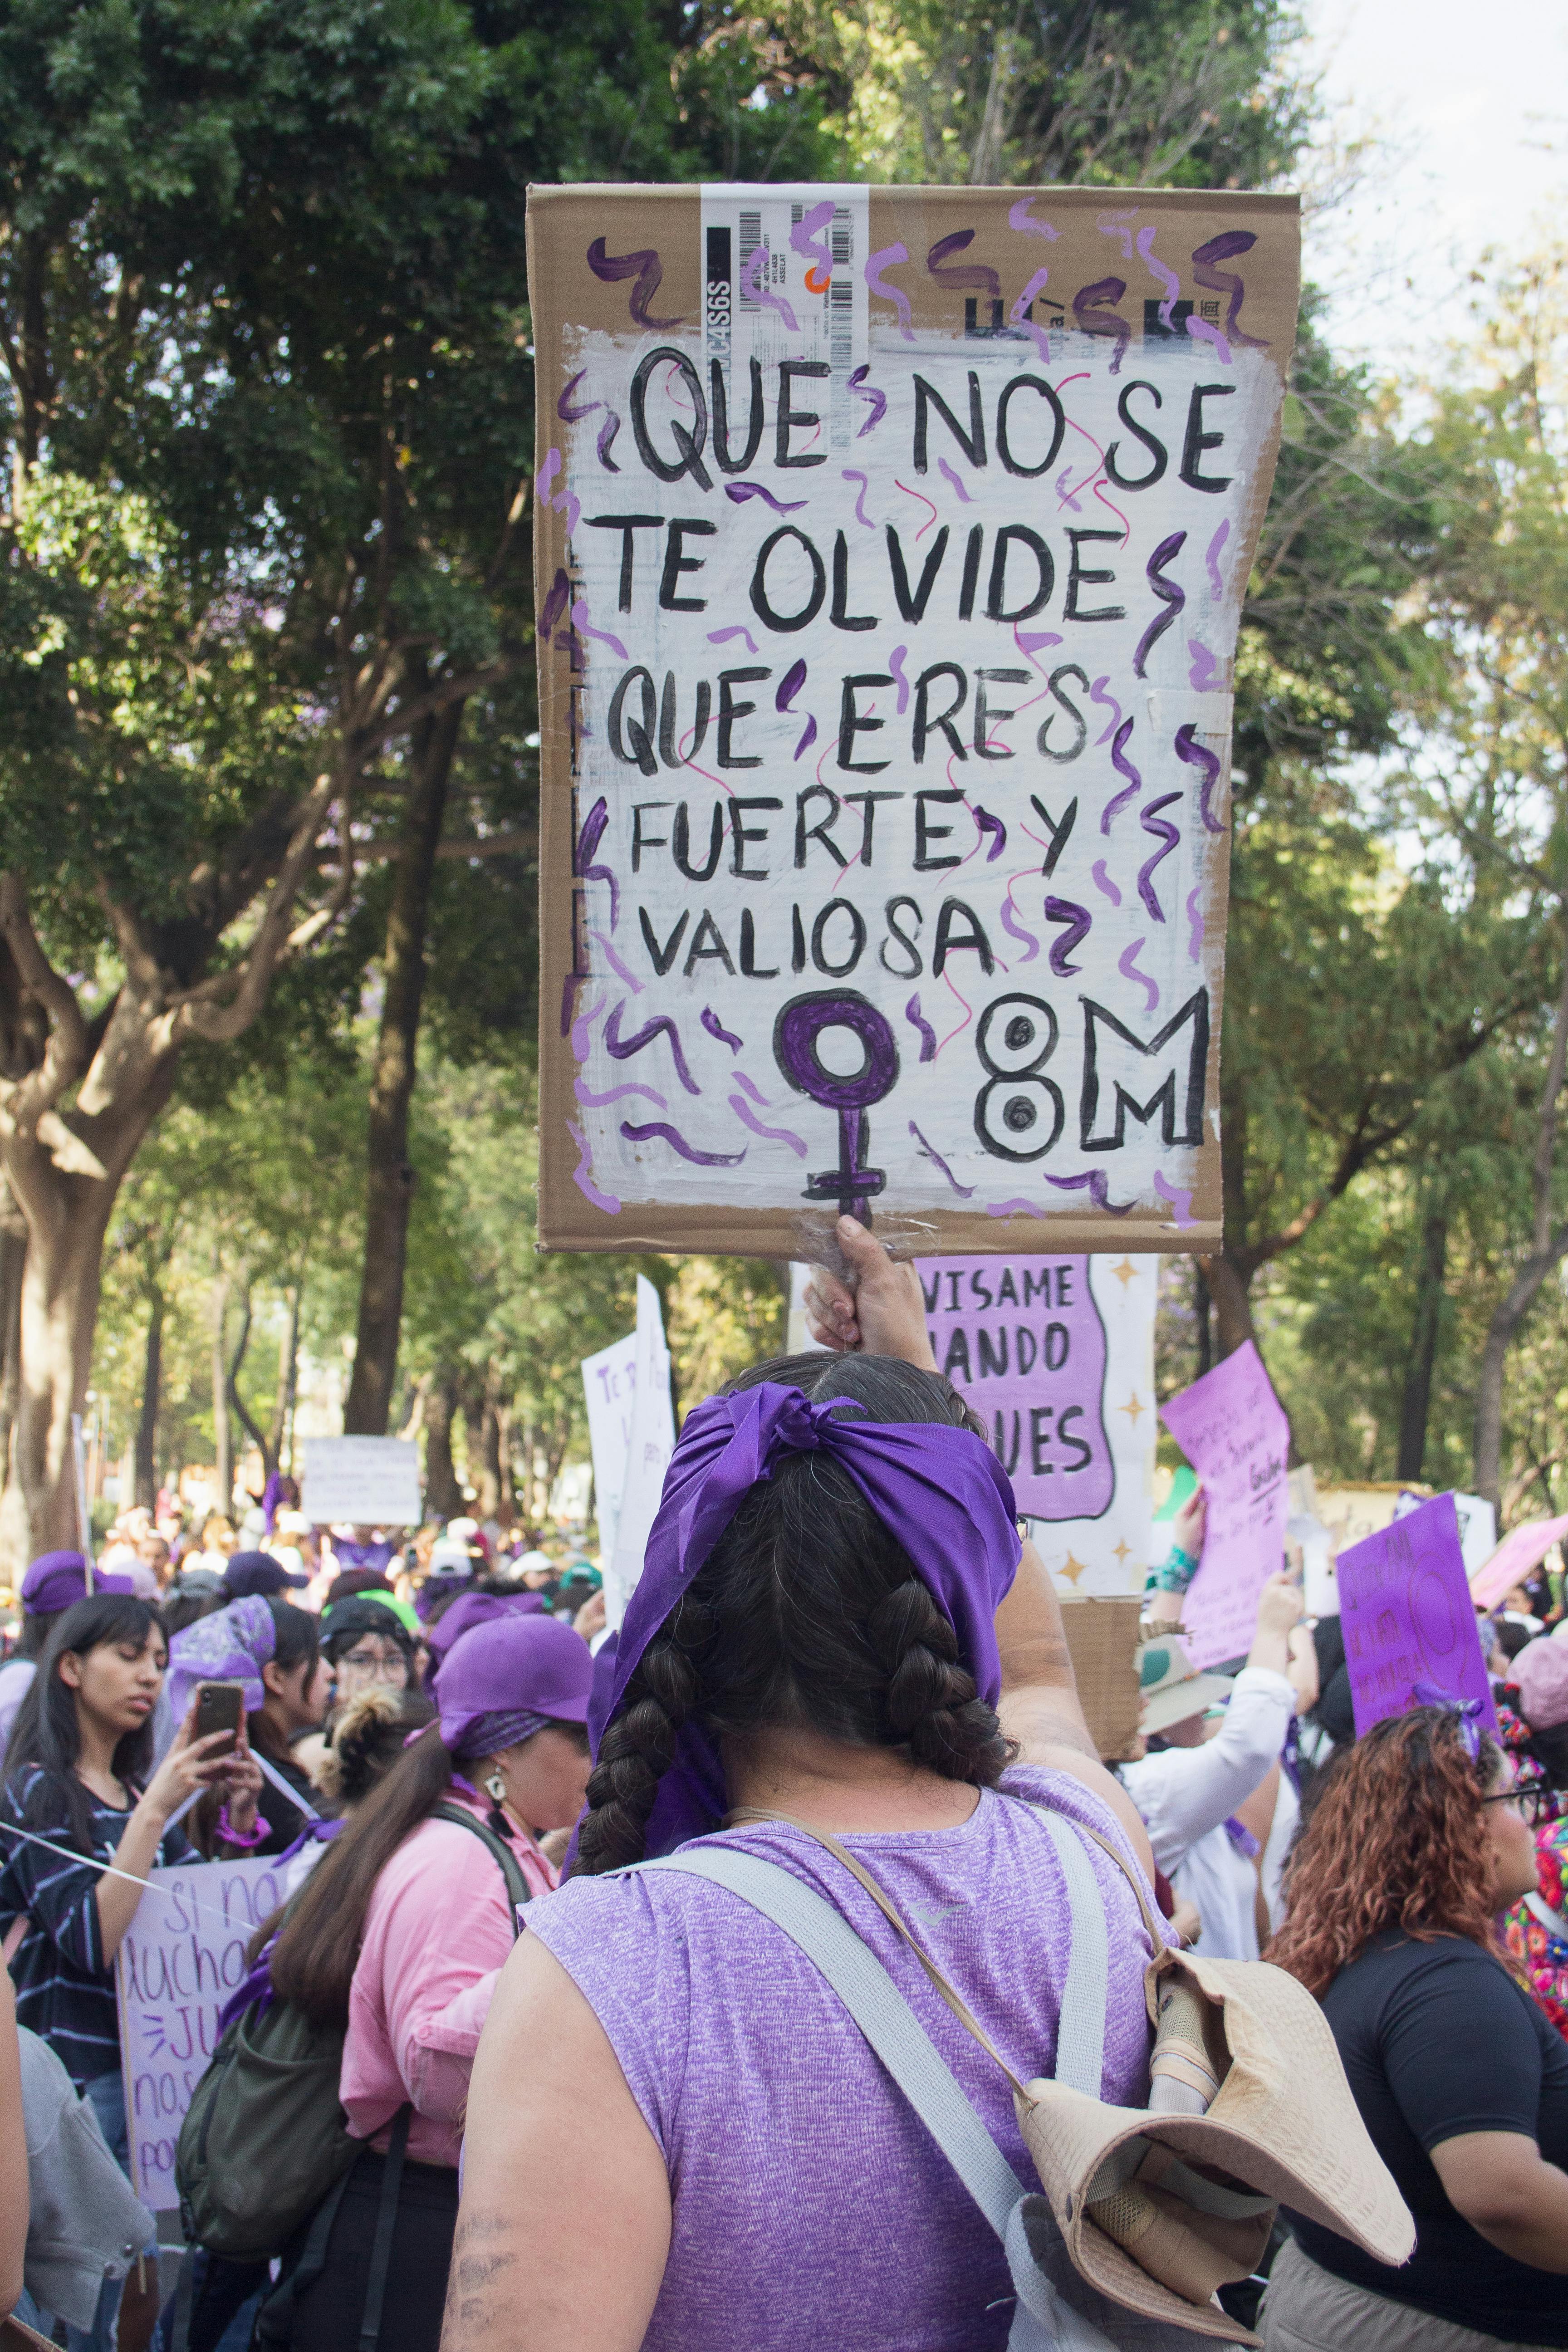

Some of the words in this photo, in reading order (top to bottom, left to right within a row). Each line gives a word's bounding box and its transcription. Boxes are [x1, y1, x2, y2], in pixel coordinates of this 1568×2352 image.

[630, 346, 832, 492] QUE
[913, 370, 1066, 479] NO
[1104, 380, 1236, 492] SE
[582, 514, 718, 613] TE
[749, 524, 1129, 633] OLVIDE
[608, 665, 773, 777] QUE
[837, 662, 1090, 774] ERES
[631, 784, 966, 881] FUERTE
[1030, 794, 1078, 879] Y
[638, 894, 995, 980] VALIOSA
[974, 985, 1210, 1164] 8M
[995, 1405, 1093, 1477] UES
